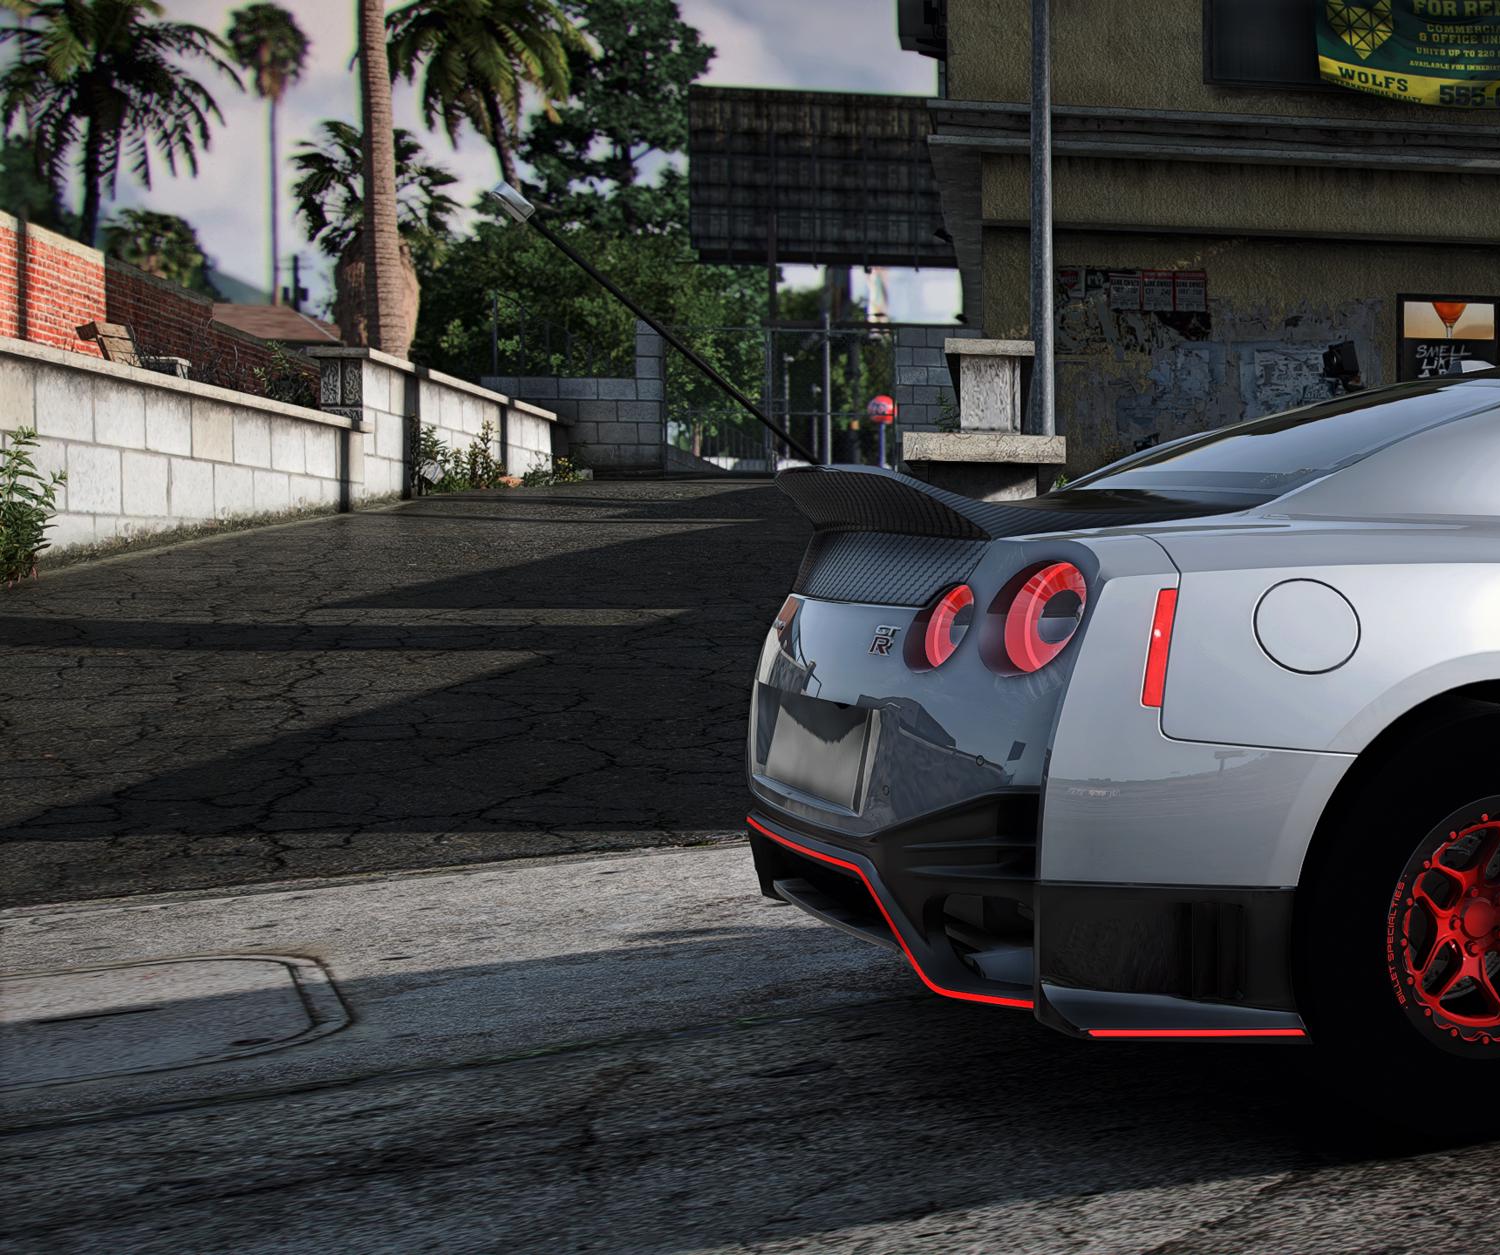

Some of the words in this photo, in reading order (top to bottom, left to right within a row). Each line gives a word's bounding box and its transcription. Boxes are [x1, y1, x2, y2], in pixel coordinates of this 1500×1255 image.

[1413, 0, 1457, 17] FOR
[1432, 33, 1478, 44] OFFICE
[1415, 47, 1446, 56] UNITS
[1448, 48, 1461, 57] UP
[1463, 49, 1475, 58] TO
[1408, 60, 1449, 70] AVAILABLE
[1337, 66, 1409, 93] WOLFS
[1416, 344, 1472, 358] SMELL
[1386, 881, 1405, 962] SPECIALTIES
[1388, 964, 1407, 1005] BILLET
